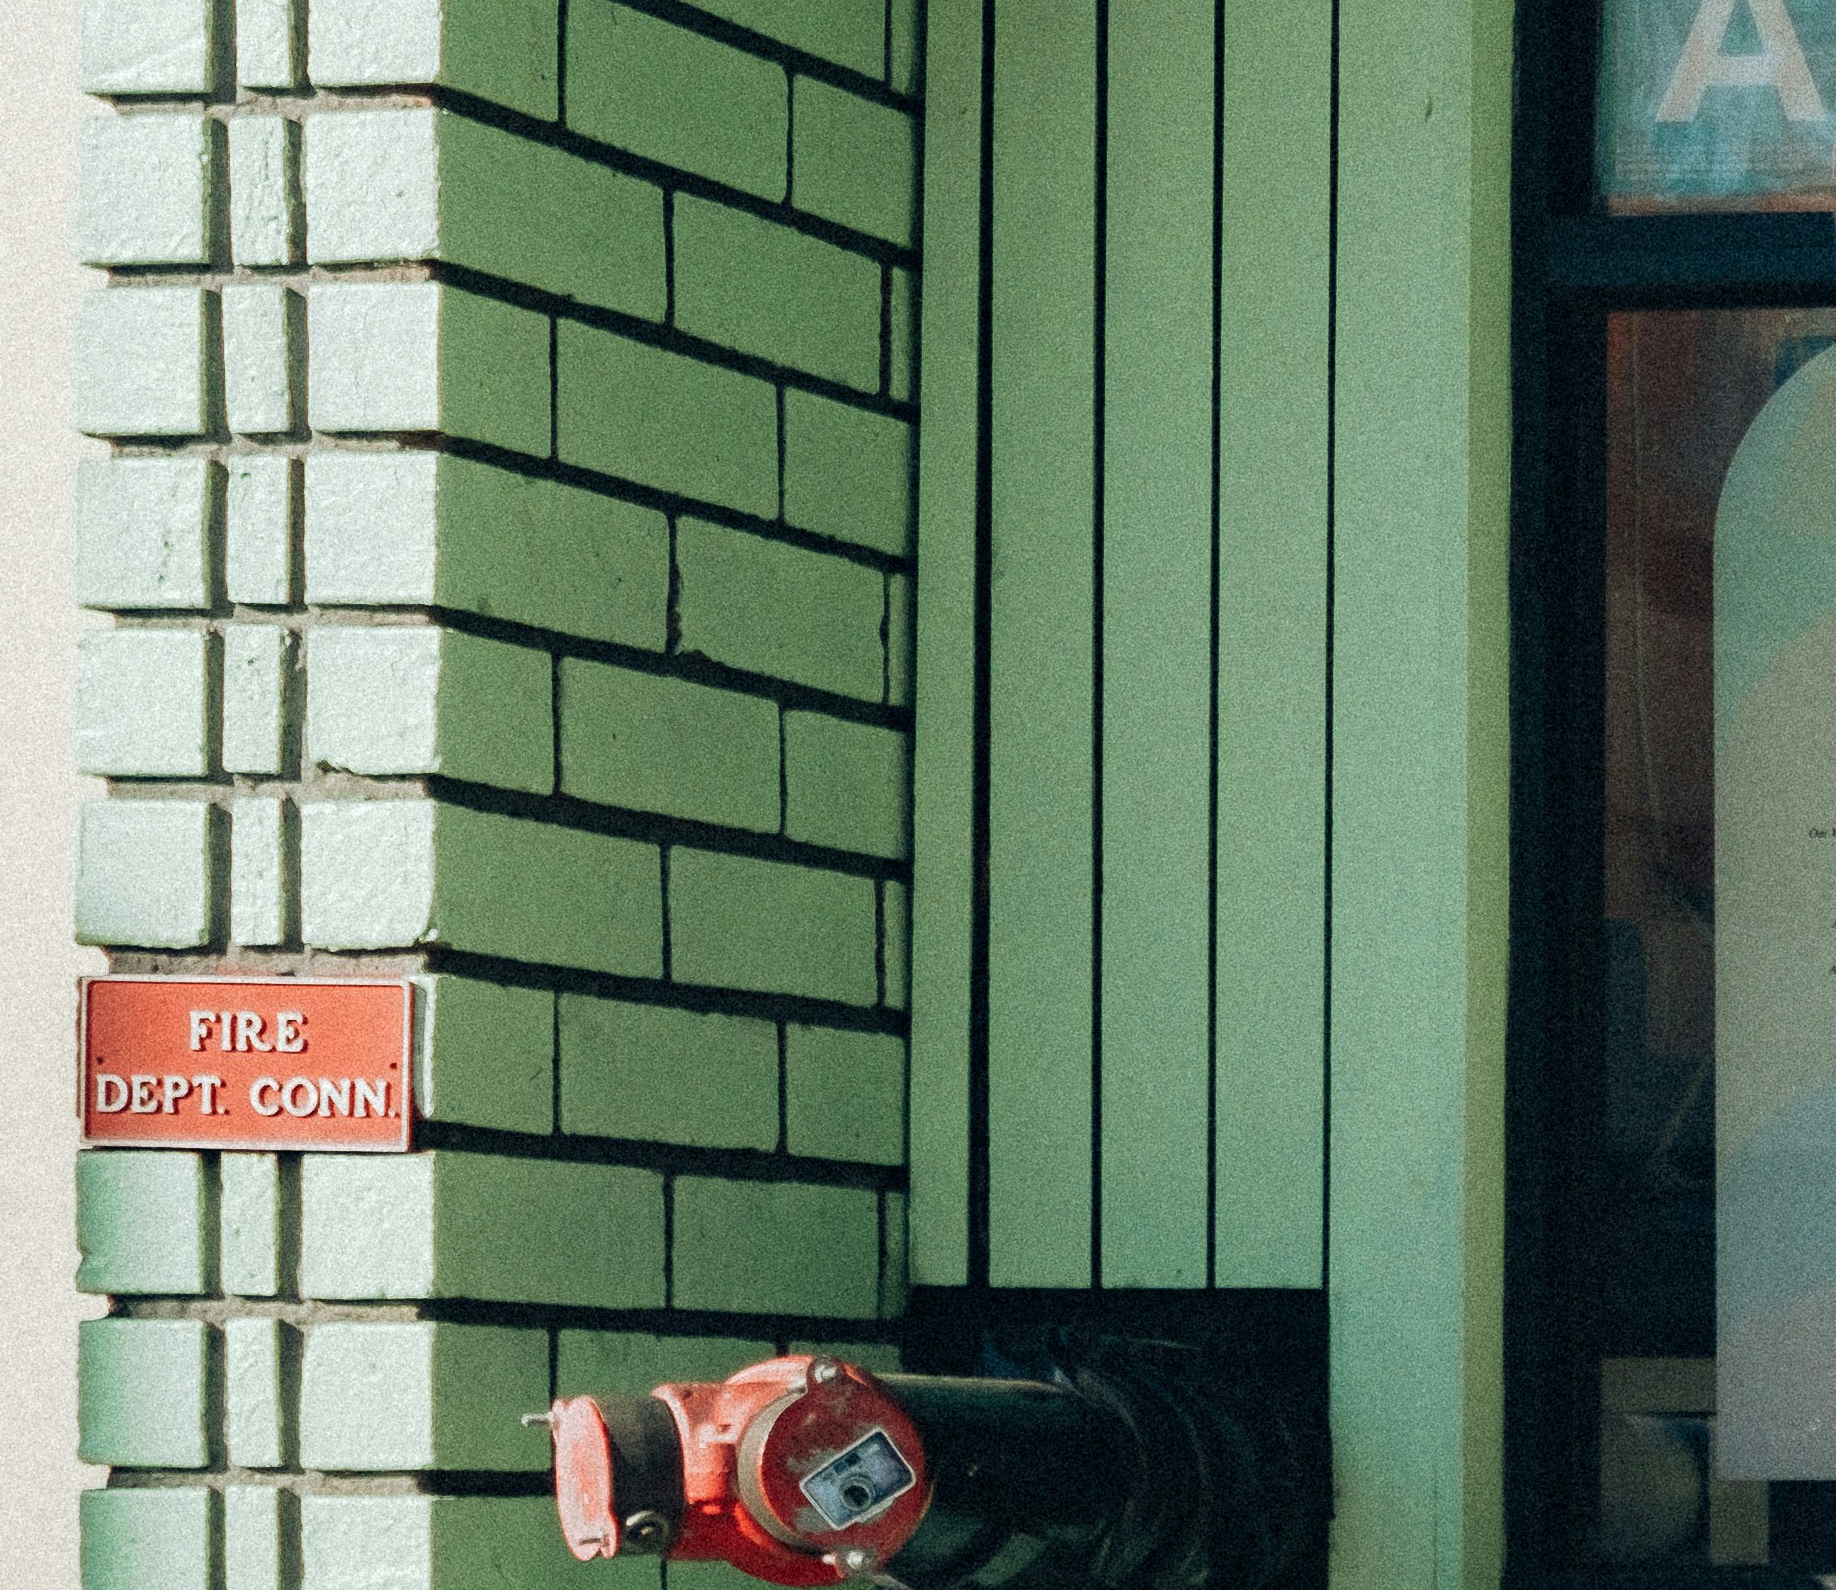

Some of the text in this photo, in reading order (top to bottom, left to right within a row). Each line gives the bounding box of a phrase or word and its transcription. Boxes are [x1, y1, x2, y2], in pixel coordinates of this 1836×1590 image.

[189, 1009, 306, 1053] FIRE
[95, 1074, 400, 1119] DEPT. CONN.
